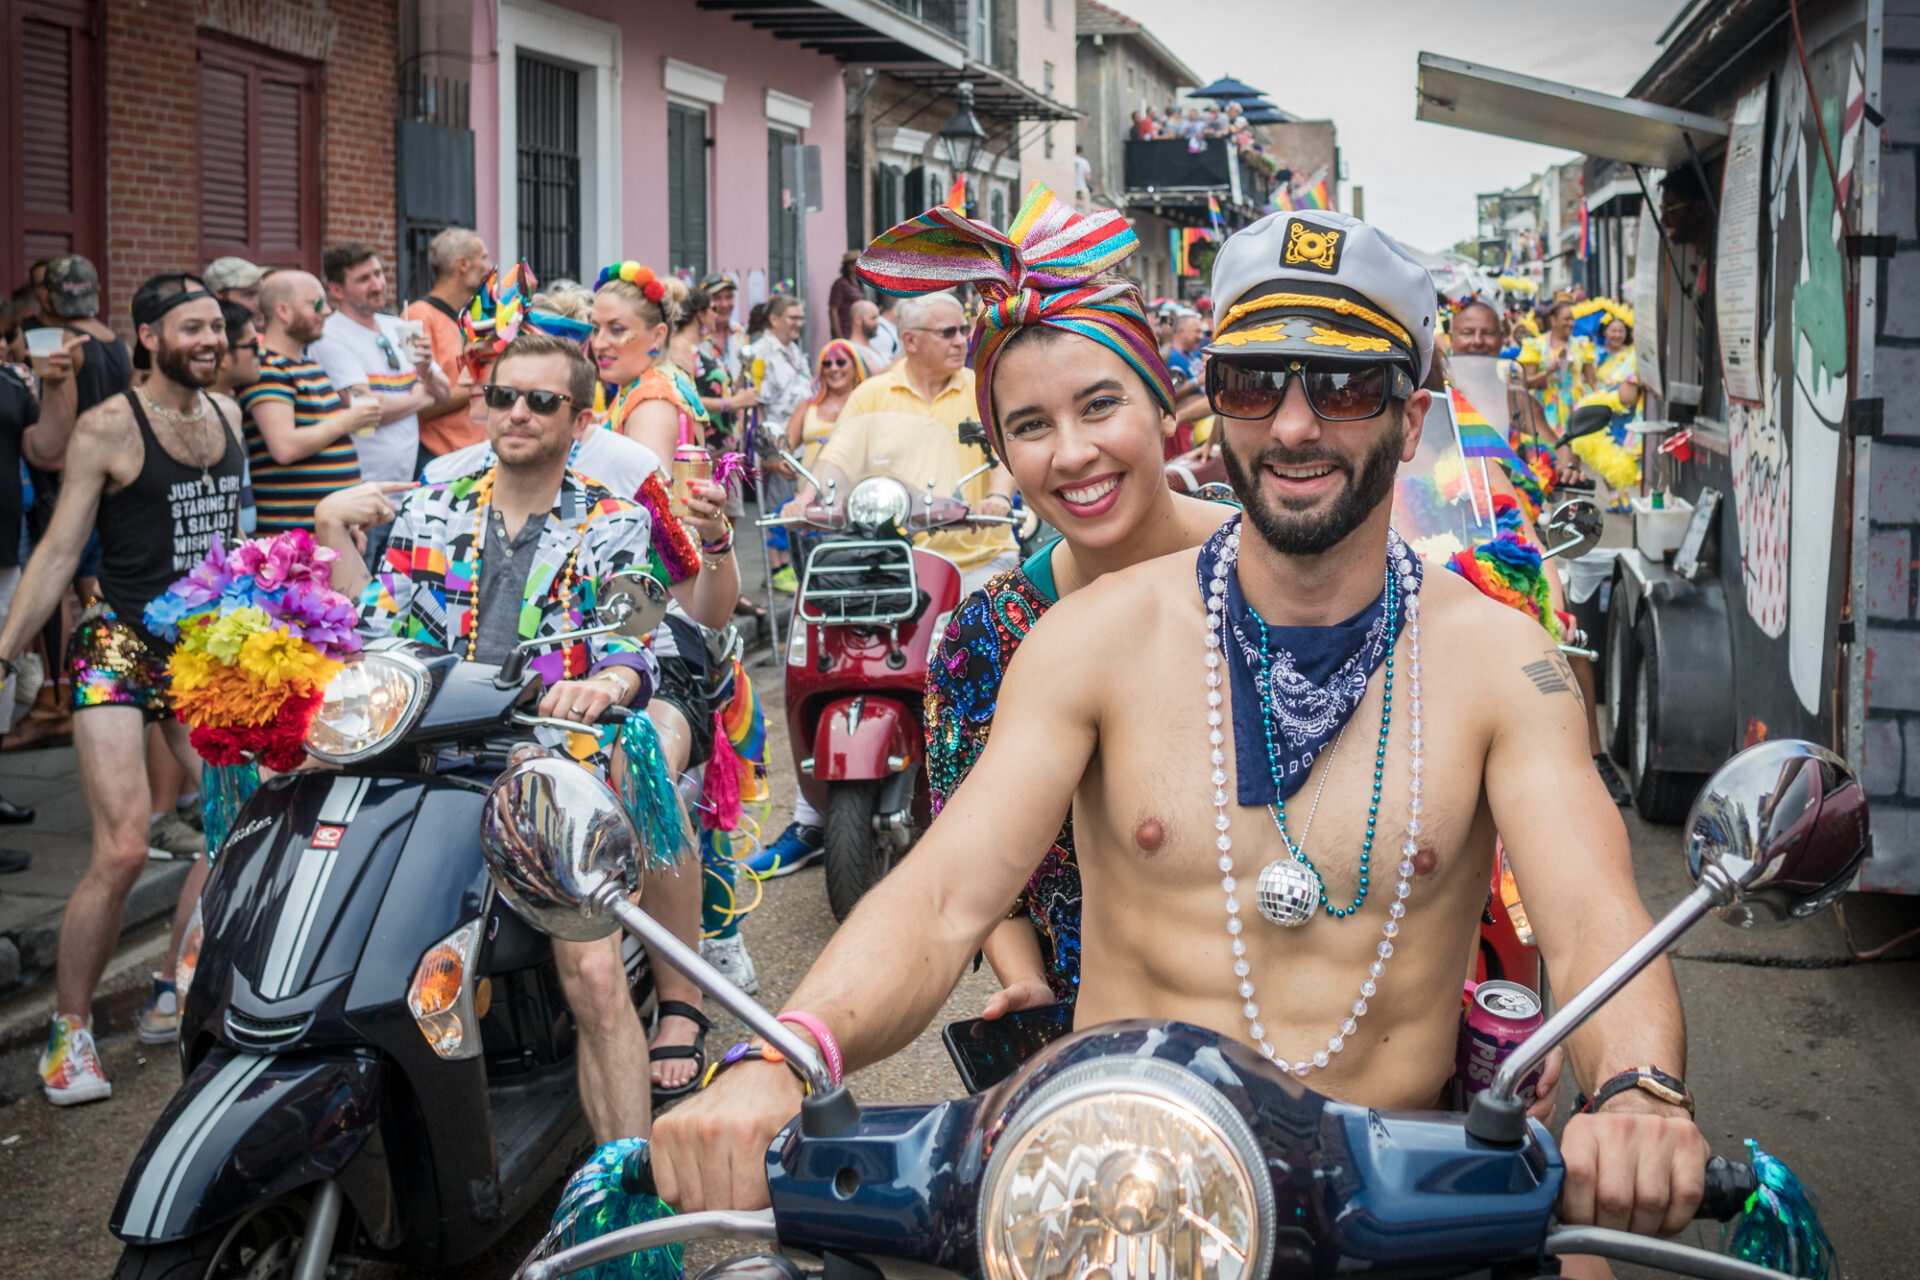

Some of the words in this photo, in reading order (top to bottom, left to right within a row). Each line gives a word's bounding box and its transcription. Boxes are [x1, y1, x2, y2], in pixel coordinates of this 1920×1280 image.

[167, 480, 203, 501] JUST
[219, 475, 240, 493] GIRL
[171, 495, 225, 519] STARING
[228, 493, 238, 510] AT
[174, 519, 184, 537] A
[188, 512, 227, 535] SALAD
[173, 530, 226, 555] WISHIG
[172, 552, 203, 572] WAS
